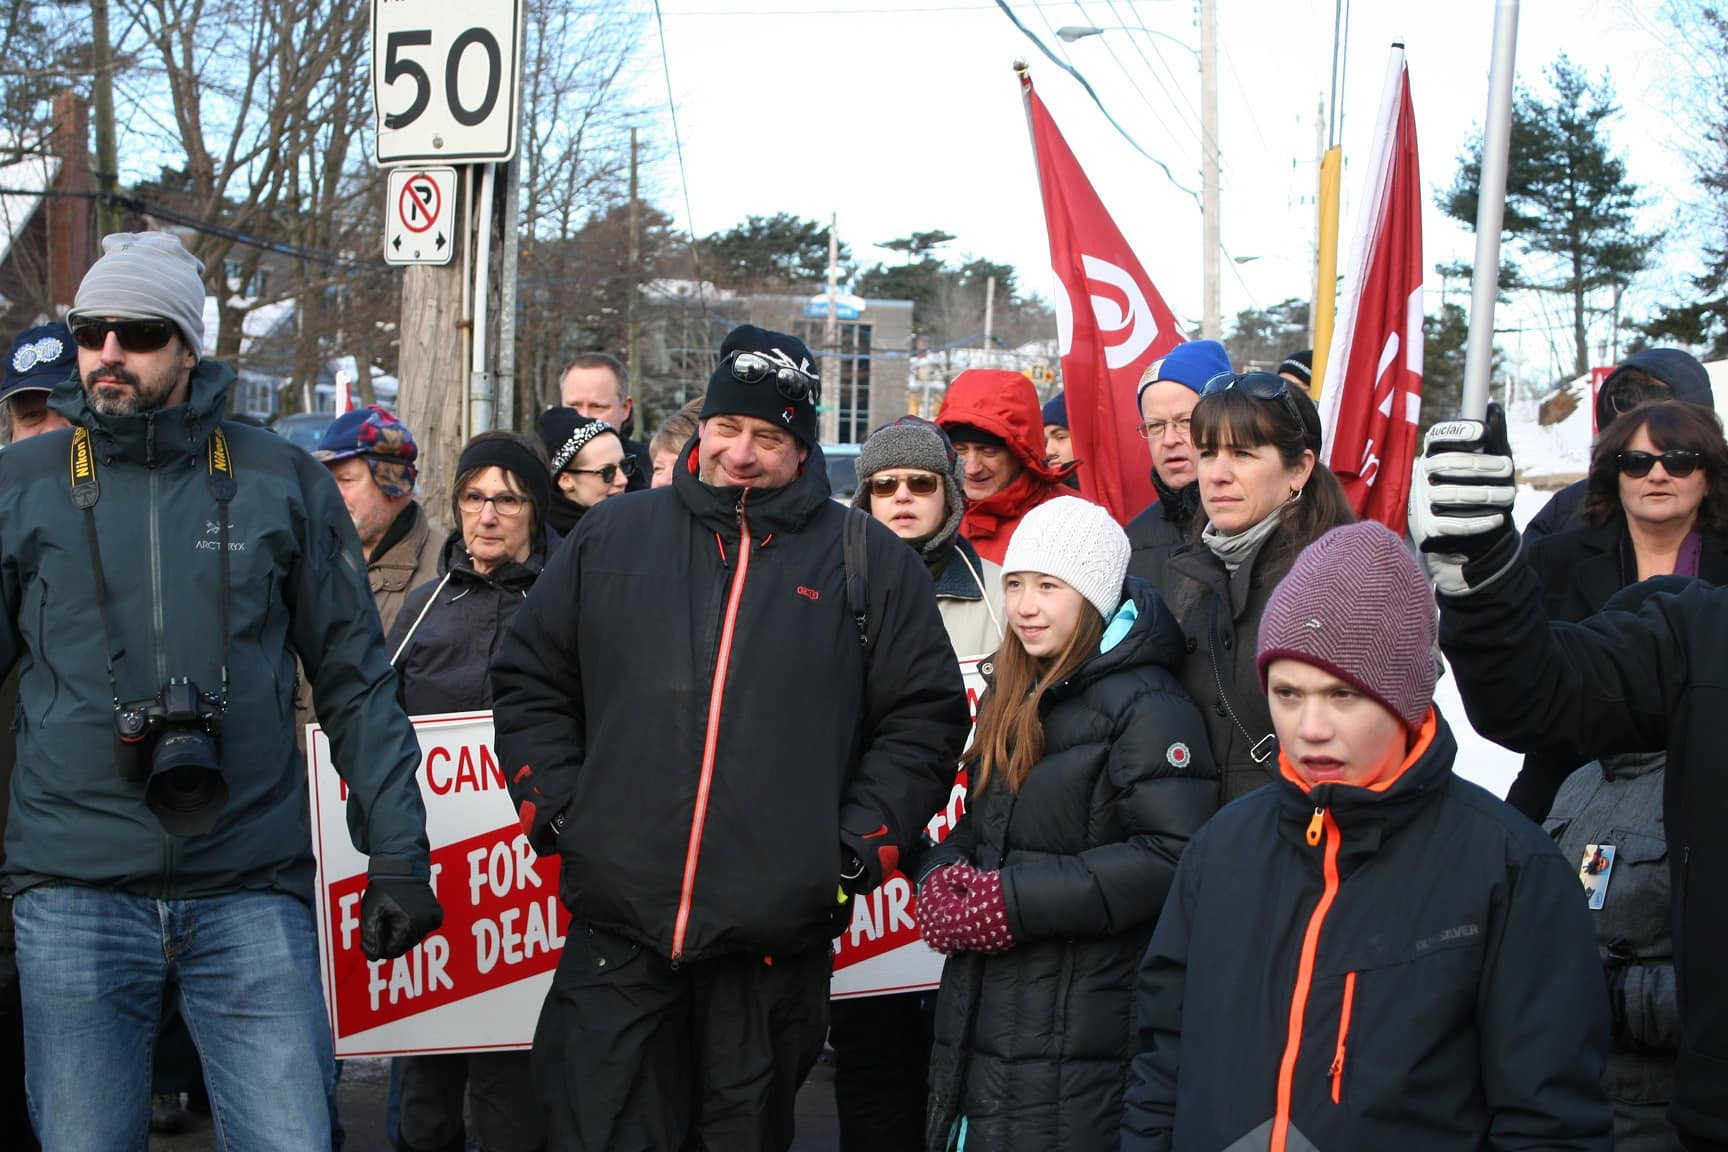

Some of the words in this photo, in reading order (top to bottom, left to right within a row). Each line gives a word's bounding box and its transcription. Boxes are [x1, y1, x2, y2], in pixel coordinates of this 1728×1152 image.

[384, 27, 502, 129] 50
[1430, 423, 1466, 438] Auclair
[75, 441, 89, 478] Nikon
[195, 540, 246, 551] ARCTRYX
[467, 834, 542, 905] FOR
[367, 934, 454, 1012] FAIR
[471, 895, 567, 975] DEAL
